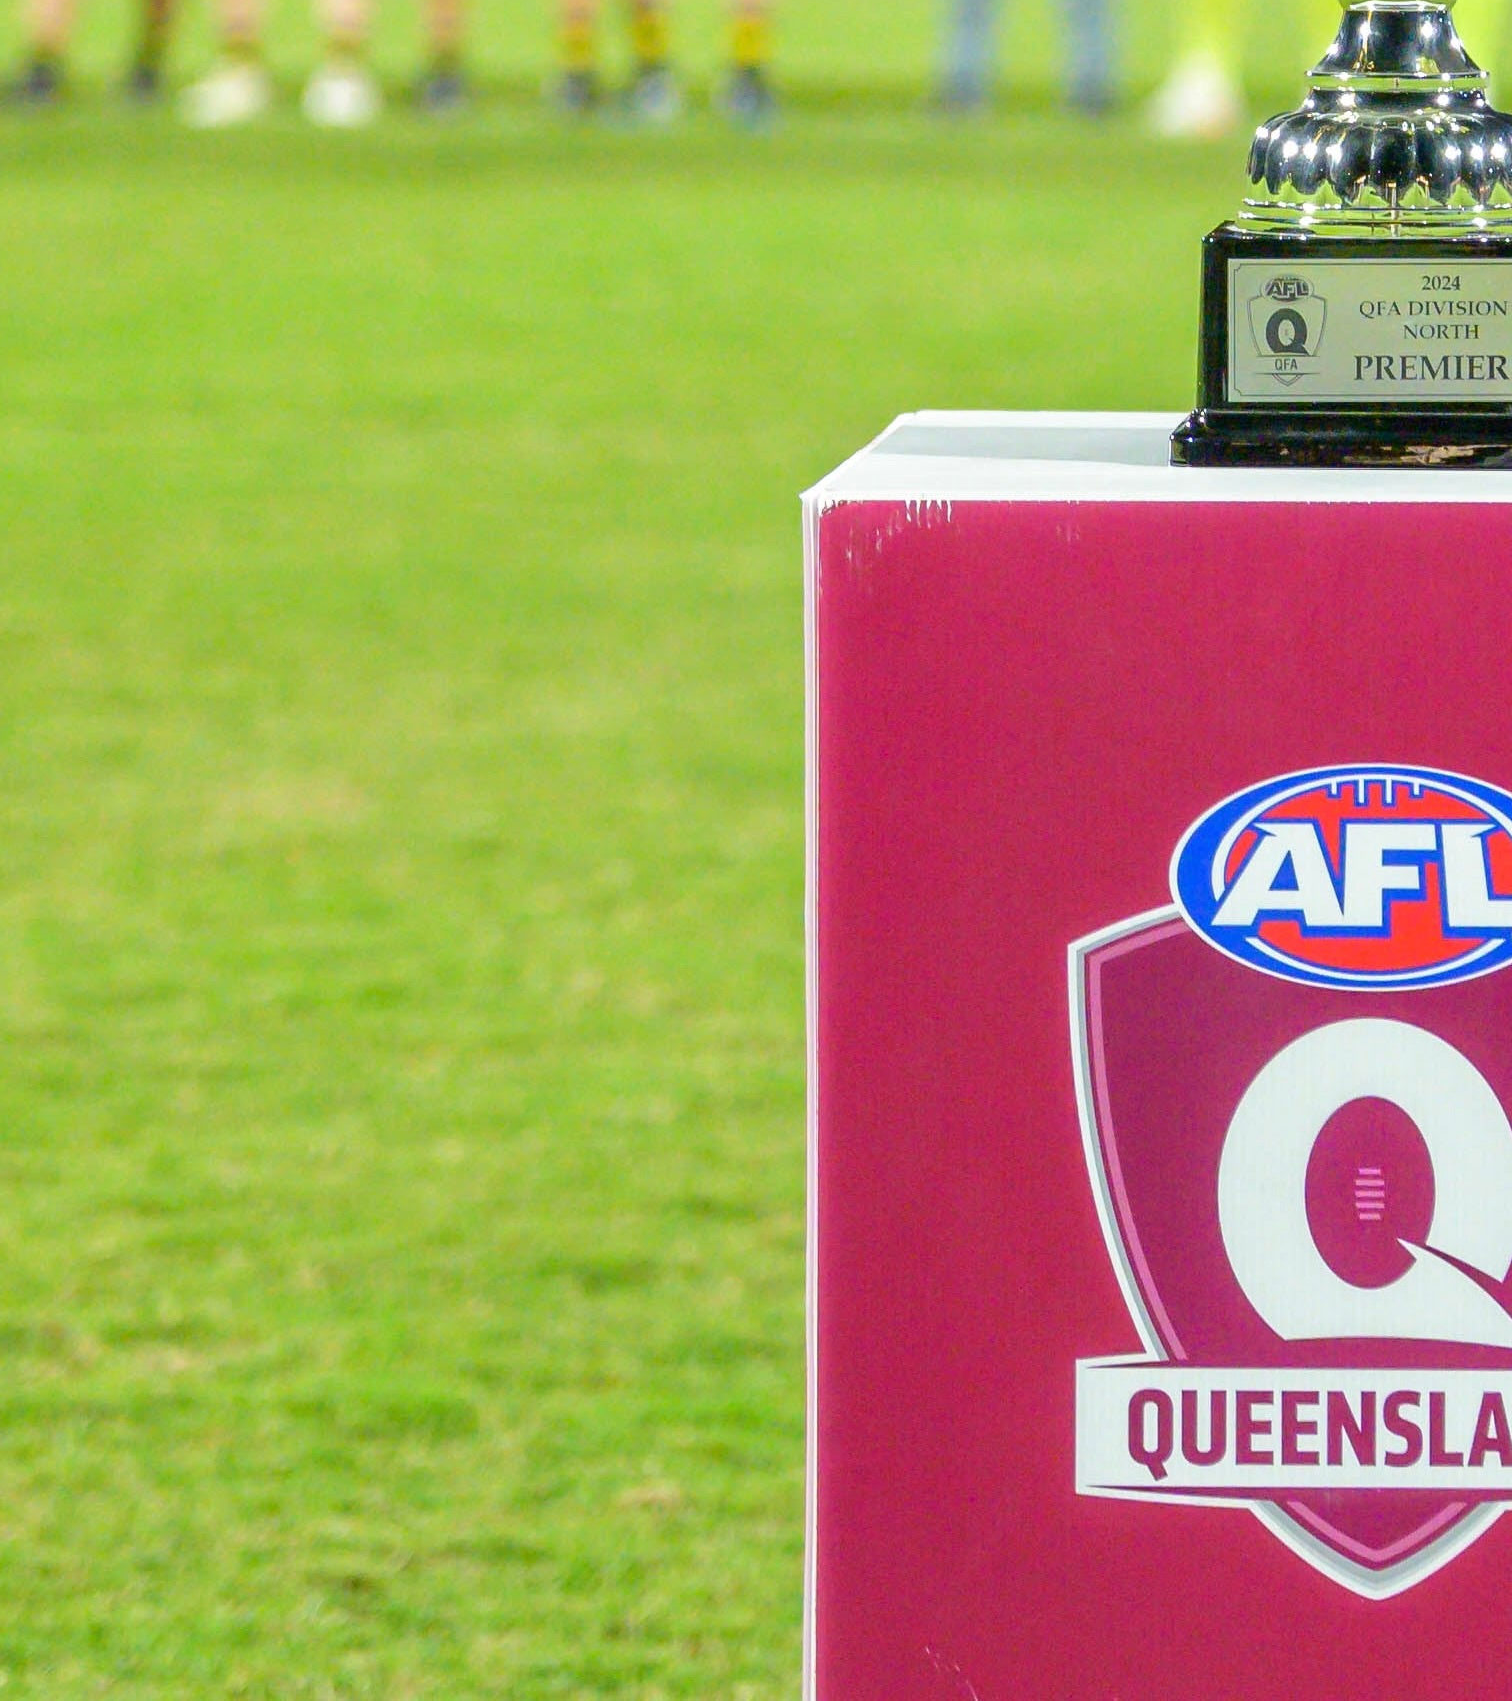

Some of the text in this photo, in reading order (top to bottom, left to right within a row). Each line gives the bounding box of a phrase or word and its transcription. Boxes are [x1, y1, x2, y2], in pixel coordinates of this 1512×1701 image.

[1264, 280, 1309, 296] AFL
[1421, 275, 1461, 291] 2024
[1359, 300, 1401, 319] QFA
[1408, 300, 1508, 316] DIVISION
[1265, 307, 1310, 356] Q
[1403, 324, 1479, 340] NORTH
[1274, 358, 1298, 371] QFA
